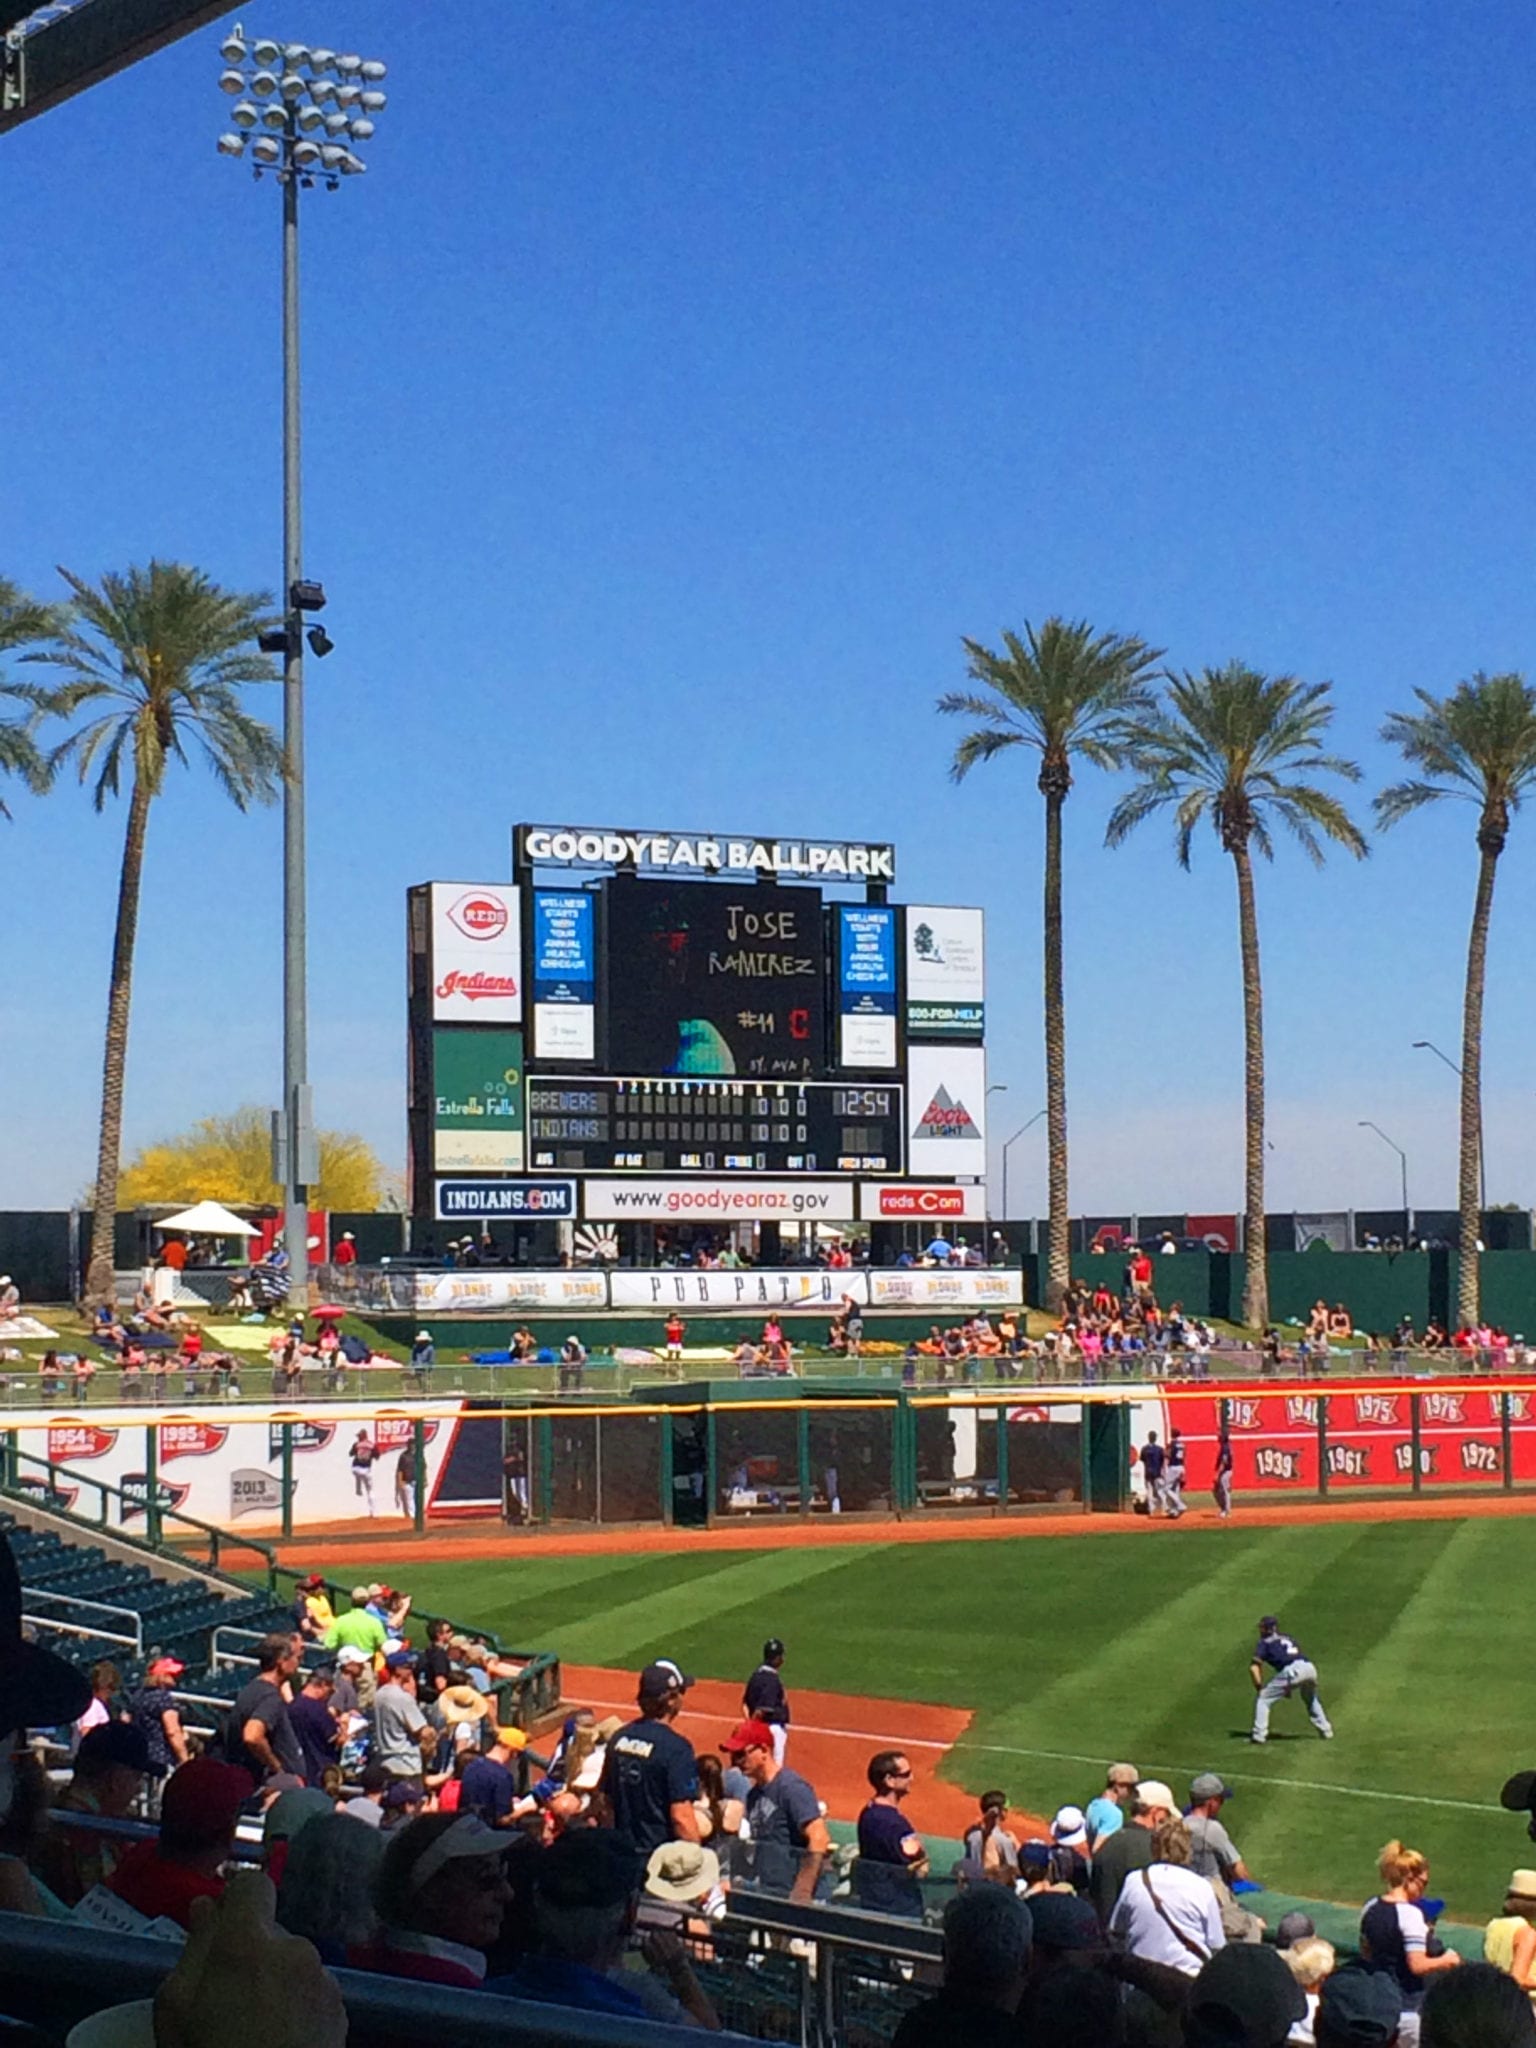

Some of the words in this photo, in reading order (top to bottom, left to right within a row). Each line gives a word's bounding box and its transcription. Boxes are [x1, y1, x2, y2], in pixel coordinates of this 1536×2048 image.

[525, 832, 721, 868] GOODYEAR
[728, 842, 894, 877] BALLPARK
[726, 905, 798, 941] JOSE
[708, 949, 816, 978] RAMIREZ
[436, 970, 517, 1001] Indians
[436, 1096, 484, 1115] Estrella
[487, 1097, 515, 1116] Falls
[532, 1119, 599, 1137] INDIANS
[930, 1124, 963, 1136] LIGHT
[447, 1189, 566, 1209] INDIANS.COM
[613, 1189, 829, 1212] www.goodyearaz.gov
[883, 1194, 915, 1208] reds
[650, 1277, 709, 1302] PUB
[1357, 1395, 1390, 1421] 1975
[1424, 1394, 1457, 1420] 1976
[50, 1428, 86, 1445] 1954
[163, 1426, 197, 1442] 1995
[1256, 1448, 1293, 1478] 1939
[1328, 1446, 1362, 1475] 1961
[1395, 1445, 1430, 1473] 190
[1462, 1442, 1497, 1470] 1972
[233, 1480, 266, 1495] 2013
